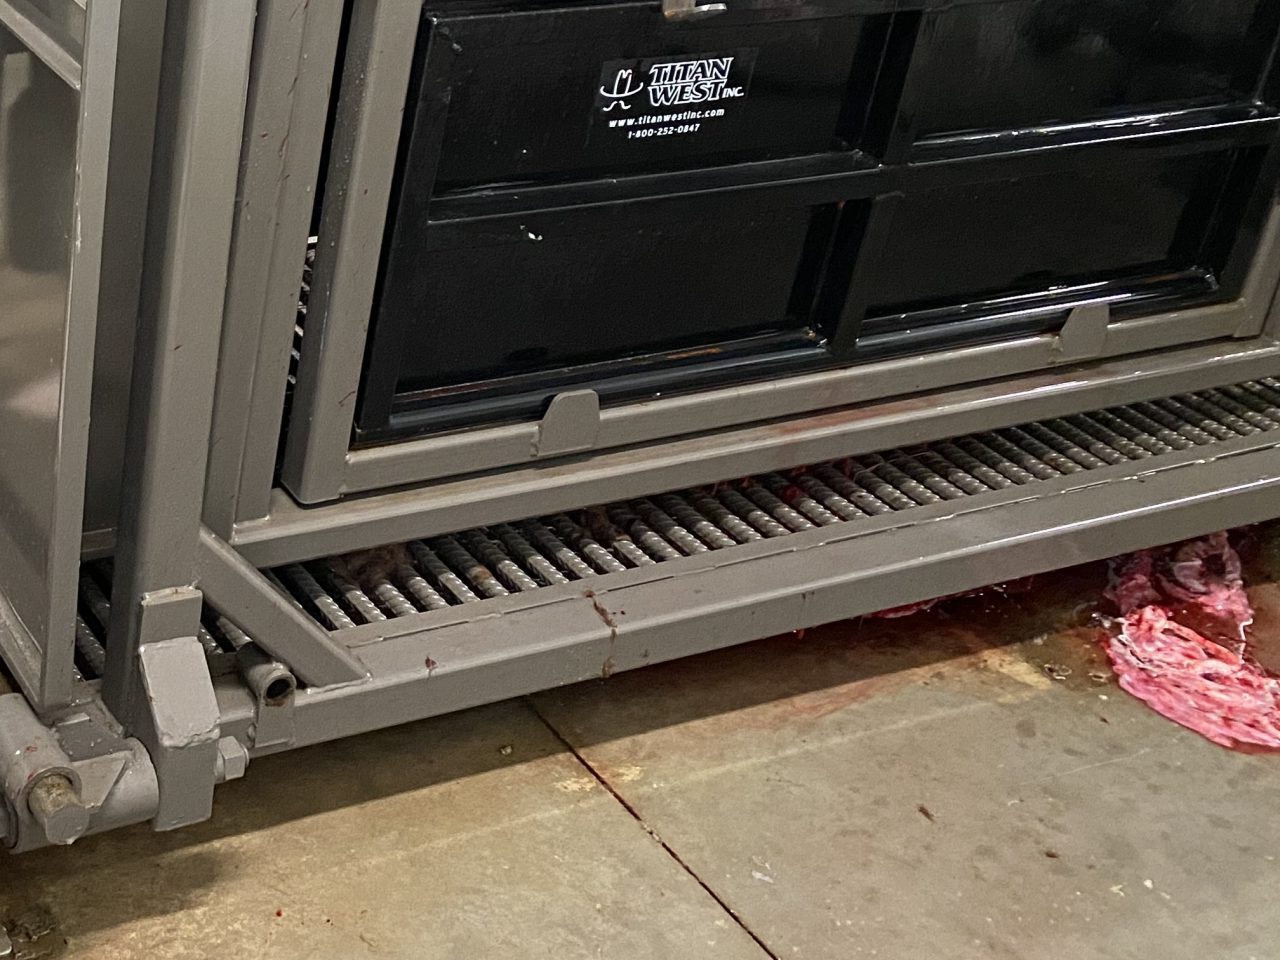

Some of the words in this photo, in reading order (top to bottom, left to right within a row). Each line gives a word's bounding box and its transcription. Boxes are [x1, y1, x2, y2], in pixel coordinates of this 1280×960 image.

[648, 57, 734, 85] TITAN
[647, 79, 727, 106] WEST
[608, 109, 725, 128] www.titanwestinc.com
[628, 123, 701, 139] 1-800-252-0847
